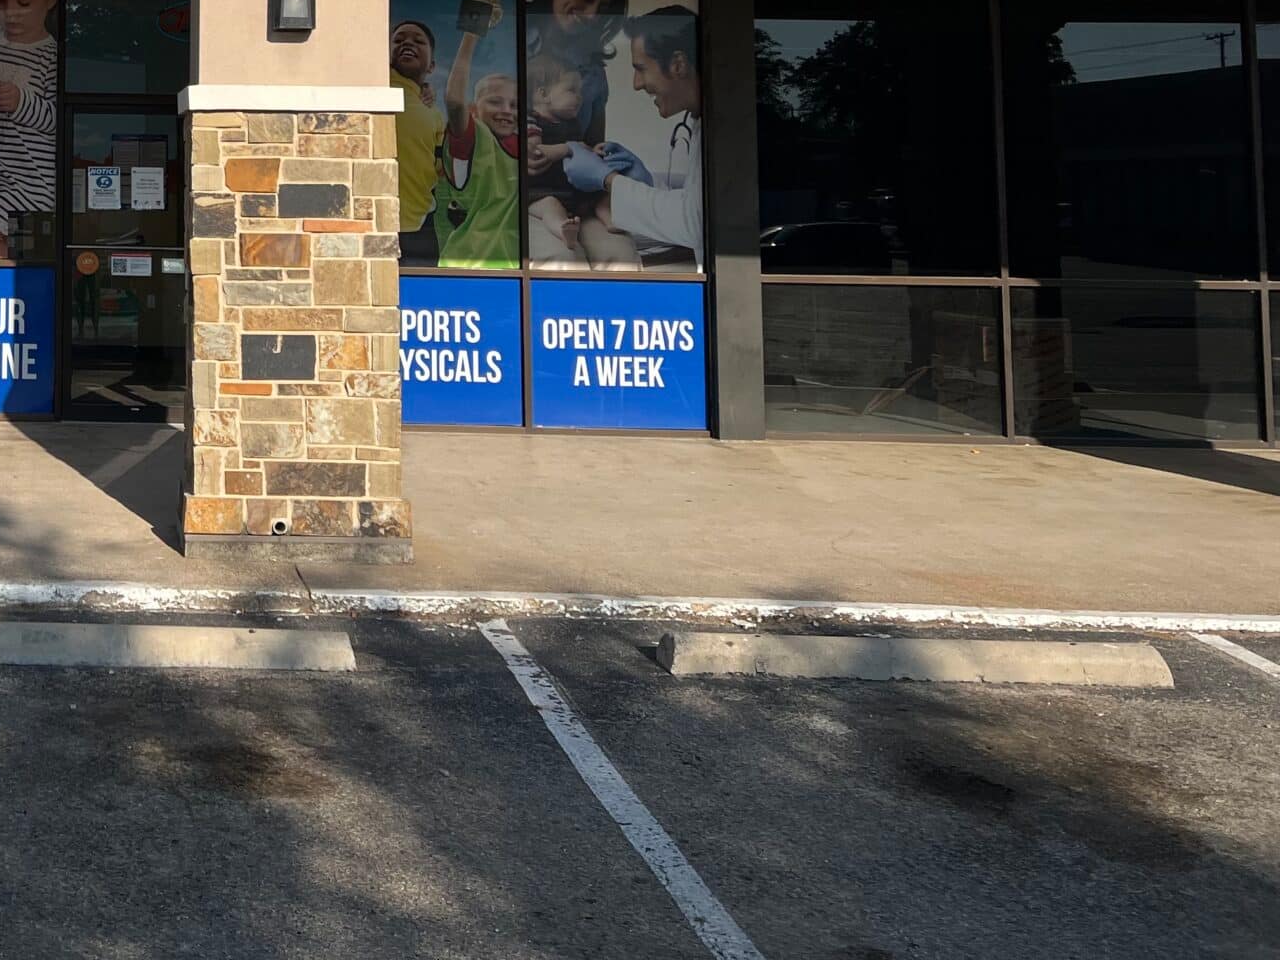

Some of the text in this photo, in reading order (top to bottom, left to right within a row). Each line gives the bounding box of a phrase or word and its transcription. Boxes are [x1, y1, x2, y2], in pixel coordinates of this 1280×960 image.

[89, 168, 119, 176] NOTICE
[400, 309, 481, 344] PORTS
[542, 318, 694, 352] OPEN 7 DAYS
[399, 348, 502, 384] YSICALS
[574, 355, 665, 388] A WEEK
